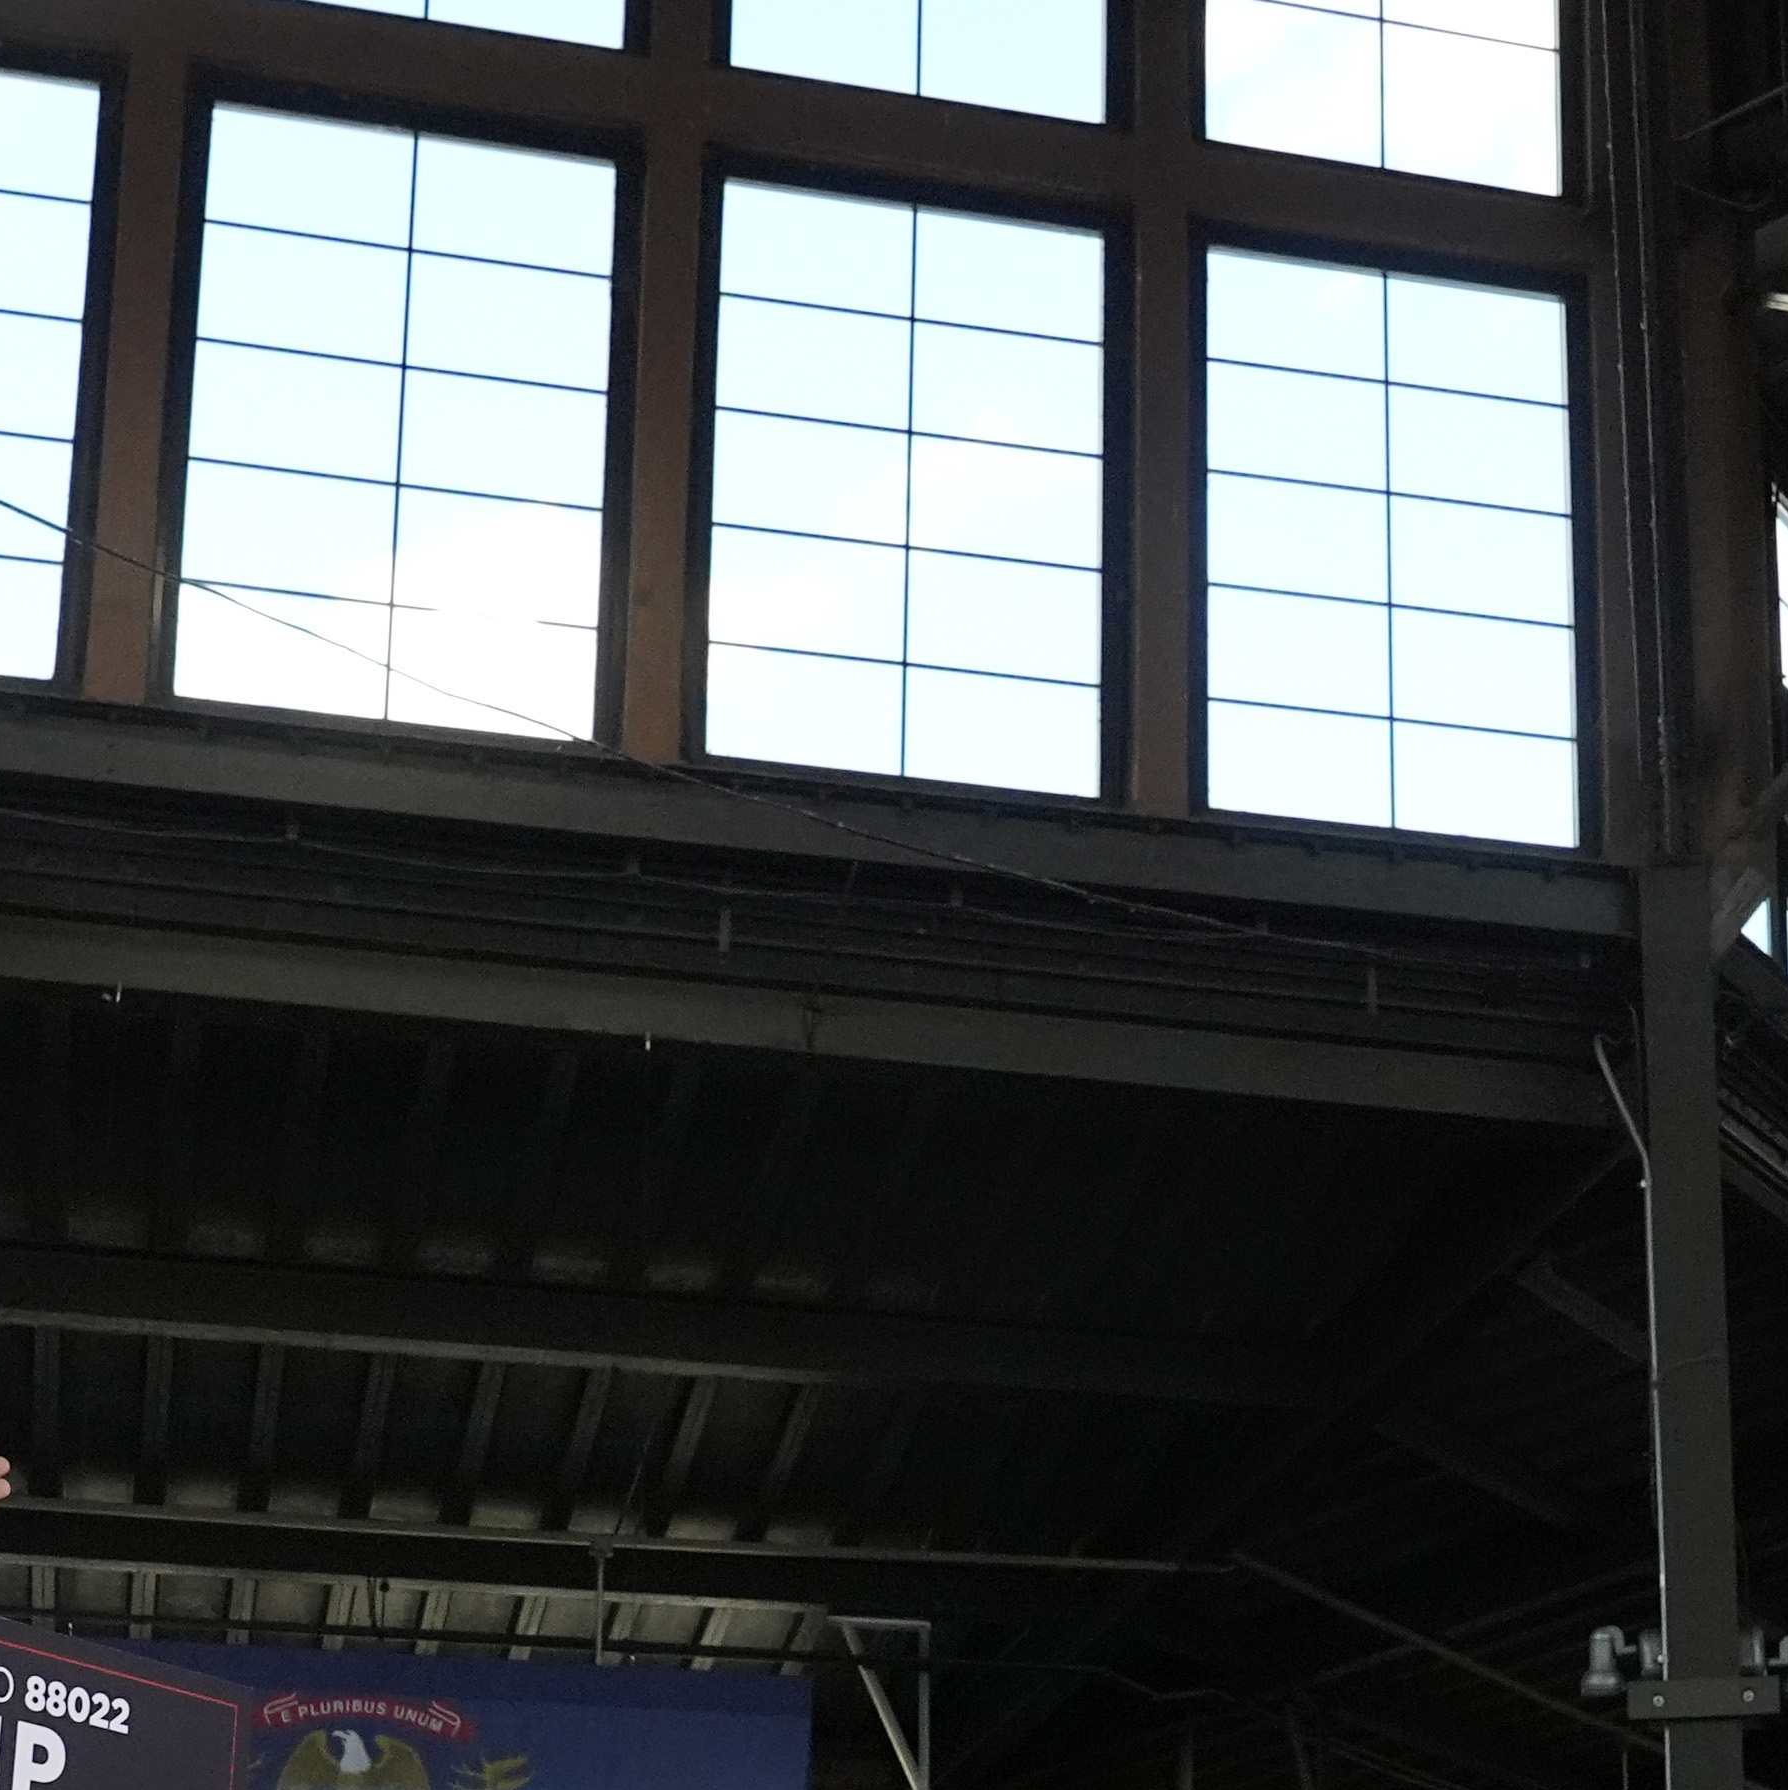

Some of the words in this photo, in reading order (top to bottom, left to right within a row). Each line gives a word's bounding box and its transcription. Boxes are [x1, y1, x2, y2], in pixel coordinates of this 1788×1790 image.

[24, 1675, 130, 1735] 88022
[297, 1699, 387, 1718] PLURIBUS
[393, 1705, 444, 1732] UNUM
